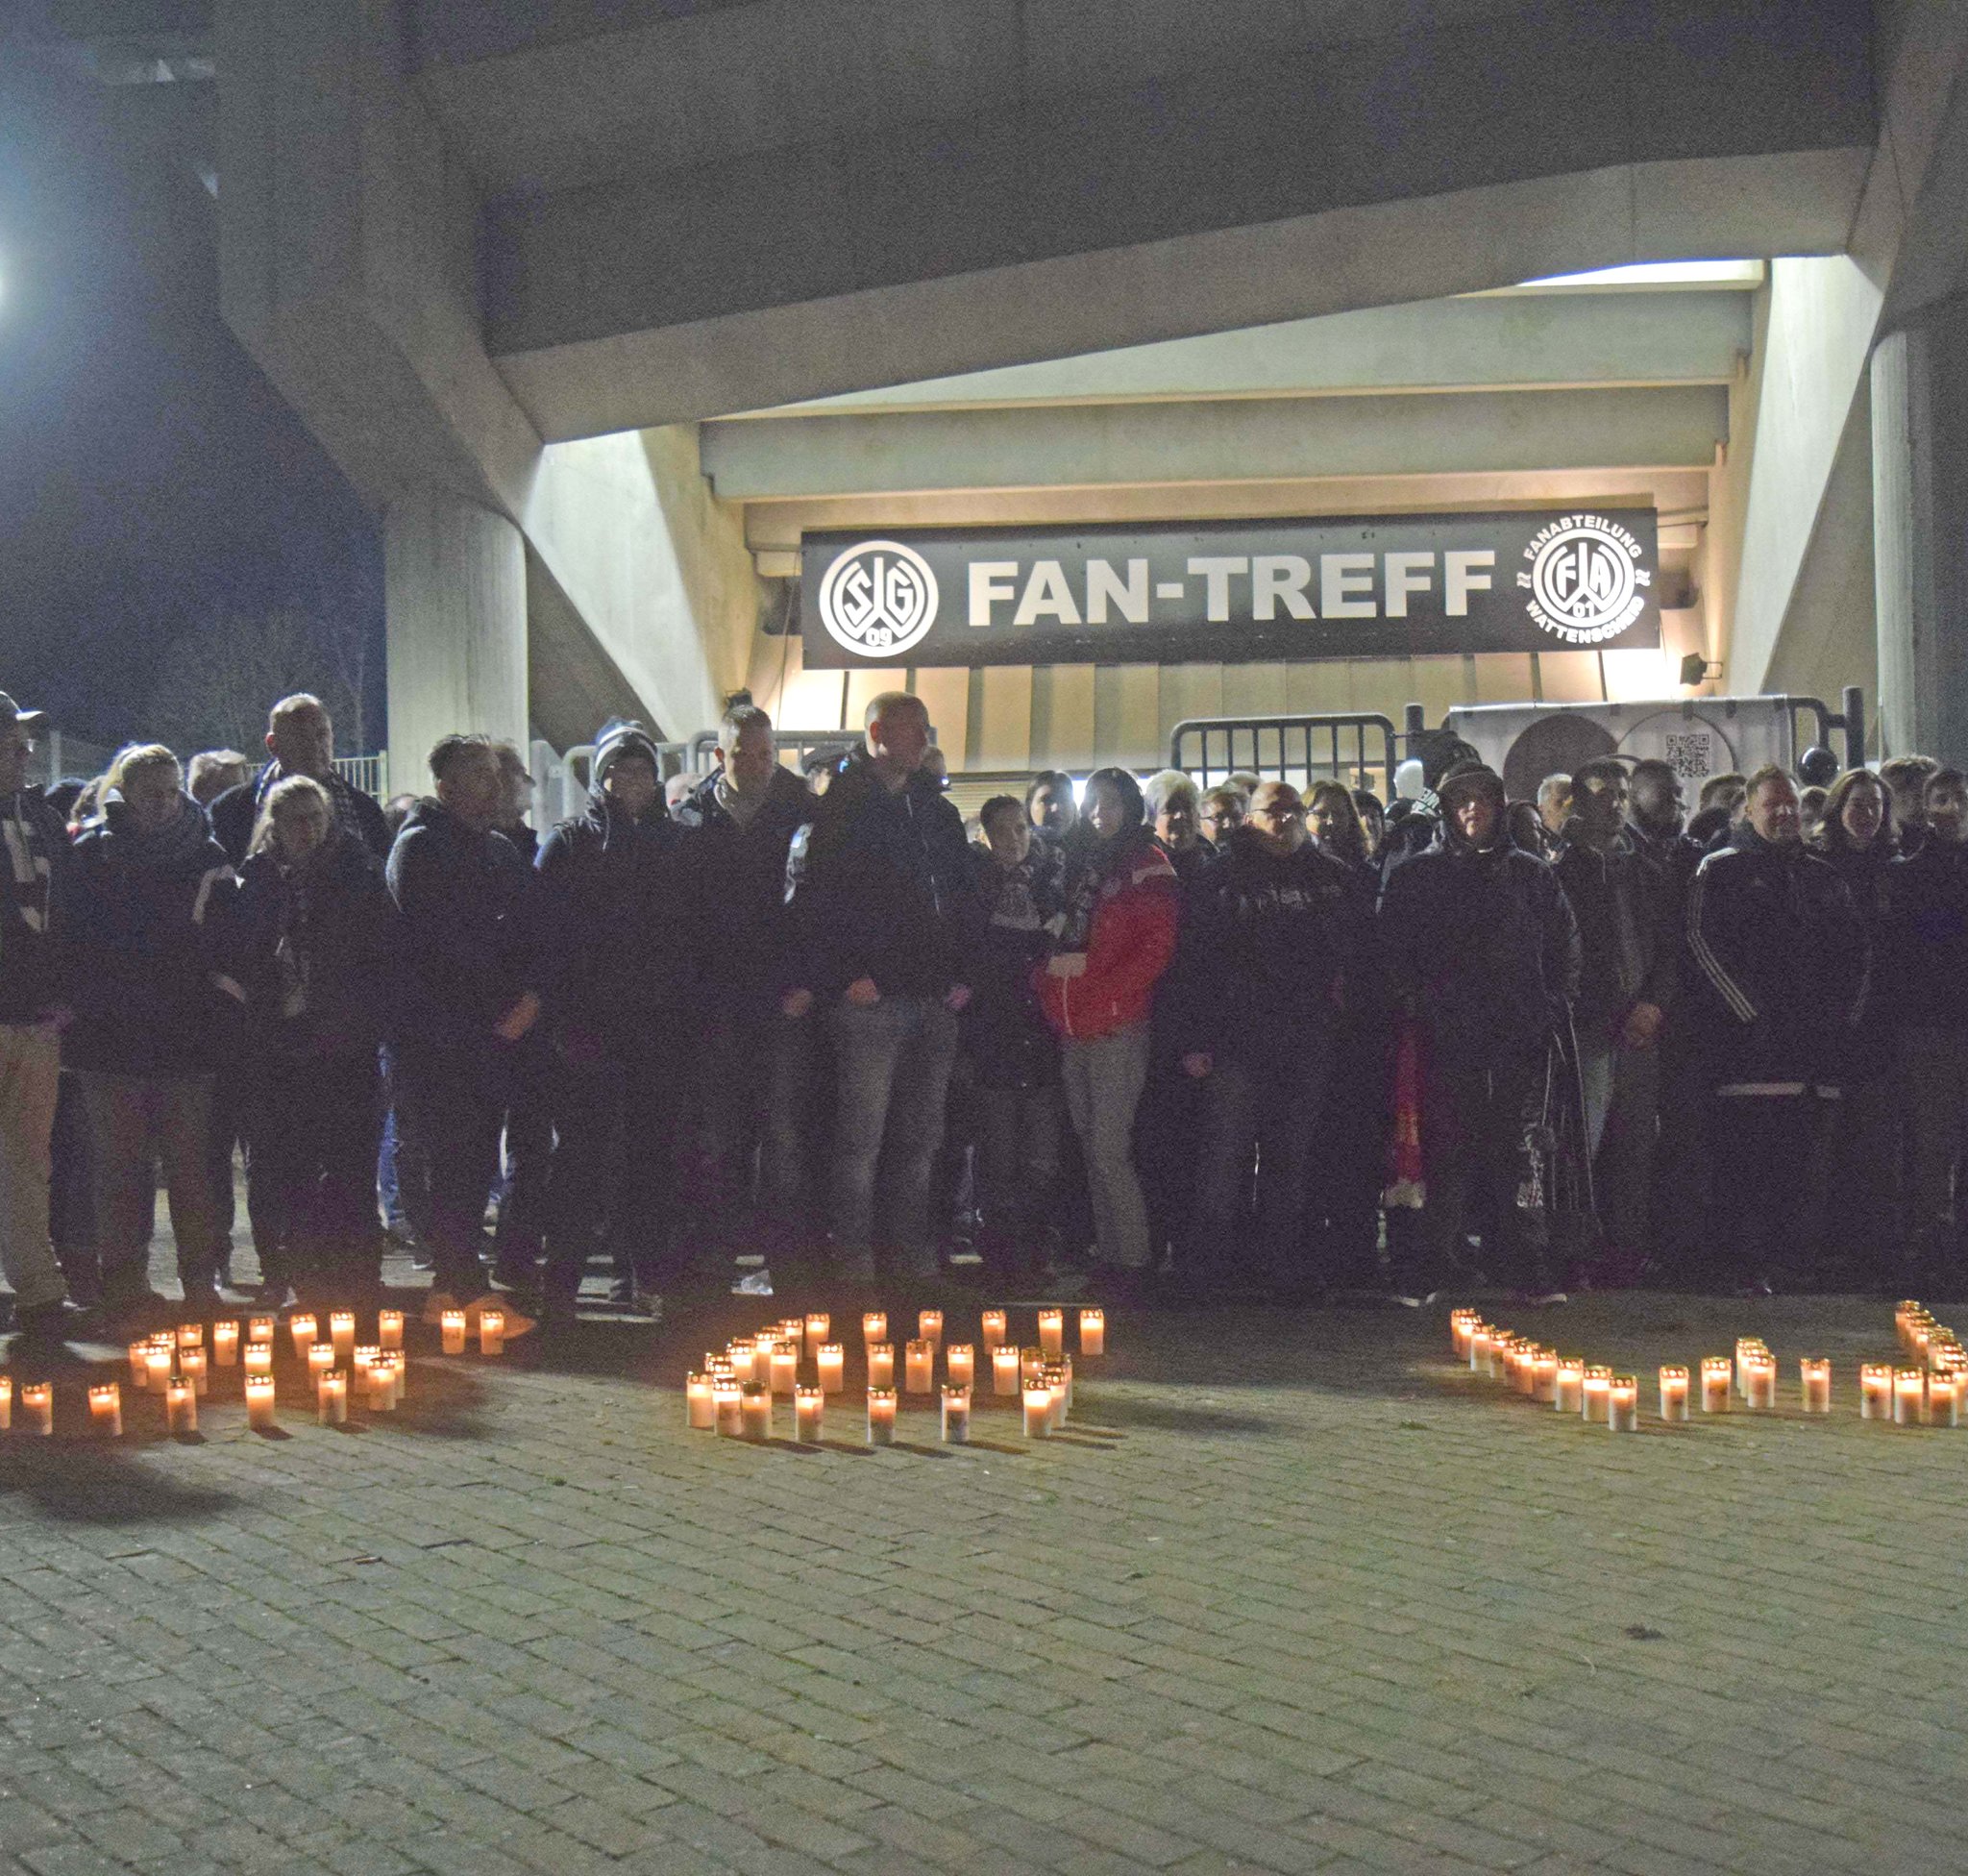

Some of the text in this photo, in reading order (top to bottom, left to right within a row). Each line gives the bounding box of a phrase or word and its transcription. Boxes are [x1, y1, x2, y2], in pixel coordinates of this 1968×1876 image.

[1523, 514, 1642, 560] FANABTEILUNG
[968, 550, 1495, 627] FAN-TREFF
[1572, 601, 1595, 618] 01
[865, 628, 893, 647] 09
[1526, 595, 1645, 644] WATTENSCHEID
